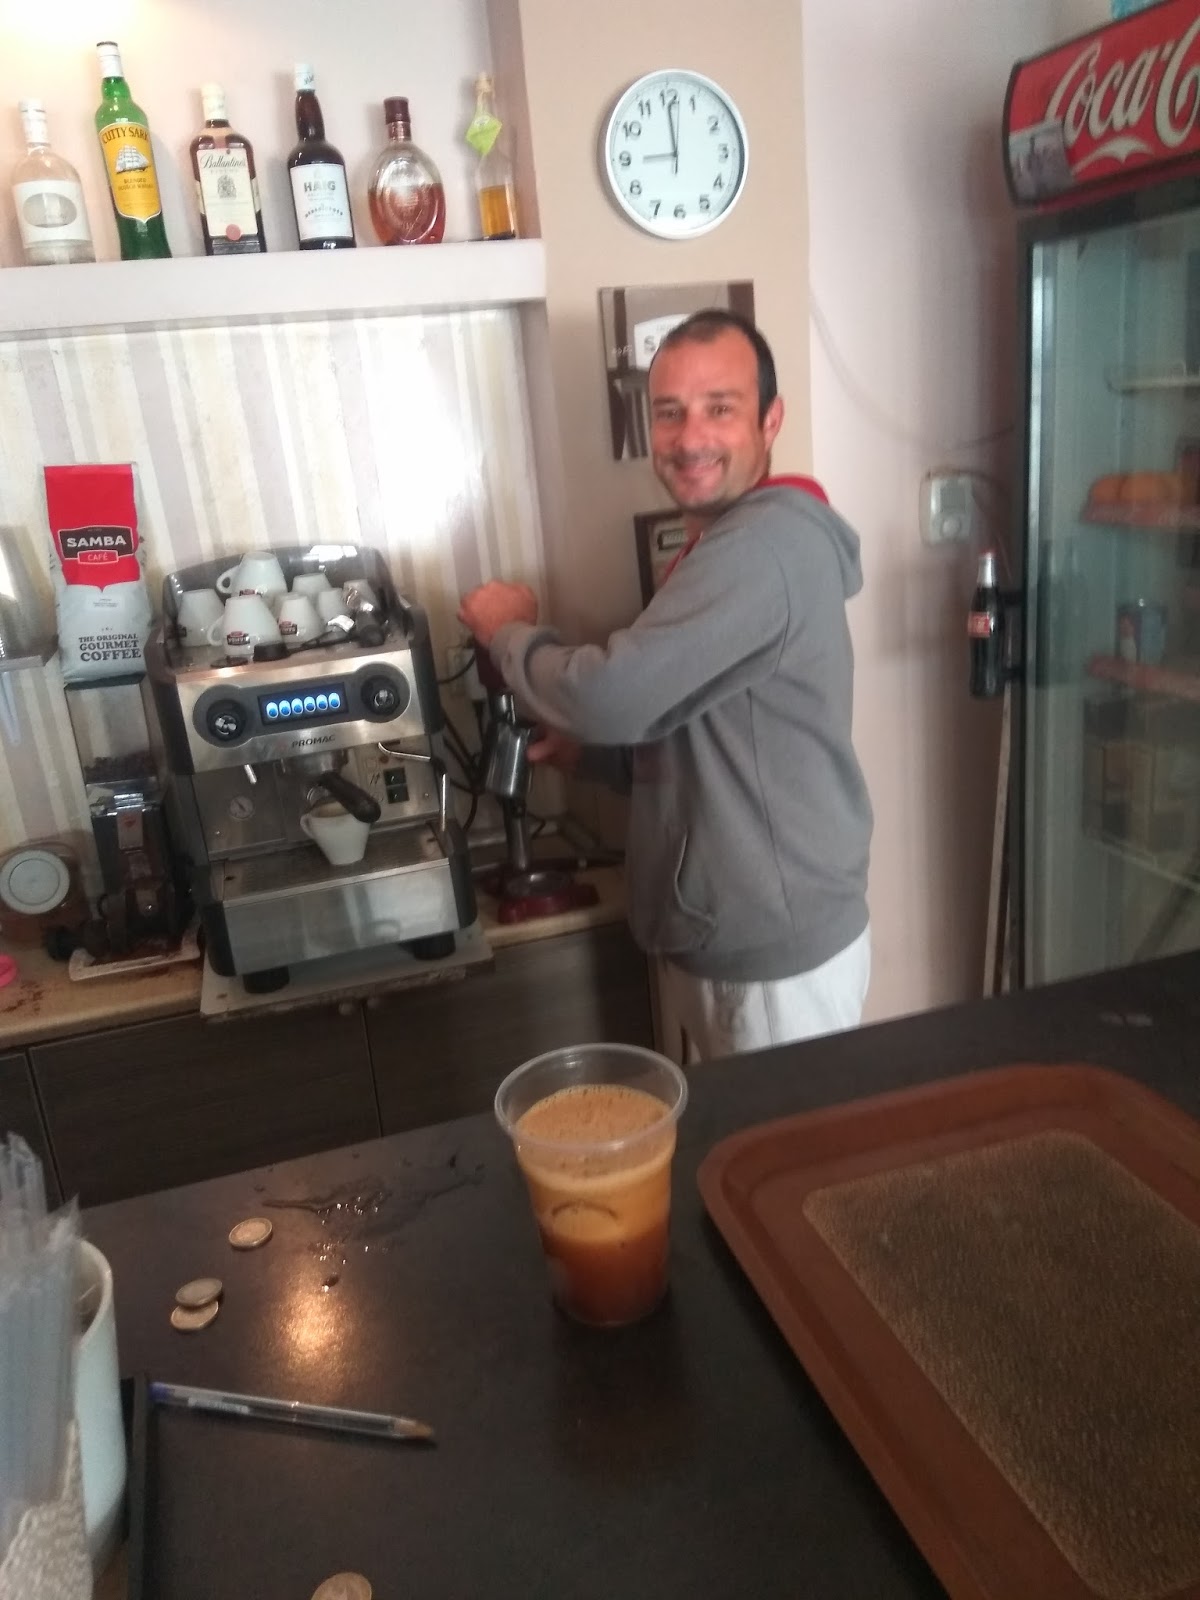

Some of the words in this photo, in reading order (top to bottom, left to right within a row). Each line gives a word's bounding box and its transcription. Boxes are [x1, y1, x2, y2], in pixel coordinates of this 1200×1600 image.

[659, 89, 678, 107] 12
[689, 94, 696, 114] 1
[638, 100, 651, 118] 11
[623, 121, 641, 141] 10
[707, 115, 719, 135] 2
[102, 127, 127, 144] CUTTY
[619, 151, 631, 168] 9
[719, 143, 729, 163] 3
[304, 180, 336, 192] HAIG
[630, 179, 642, 196] 8
[713, 175, 723, 192] 4
[650, 199, 662, 218] 7
[673, 203, 686, 219] 6
[699, 194, 710, 212] 5
[66, 535, 127, 548] SAMBA
[87, 552, 108, 561] CAFÉ
[79, 639, 139, 651] GOURMET
[96, 633, 138, 641] ORIGINAL
[80, 648, 142, 662] COFFEE
[291, 735, 336, 748] PROMAC
